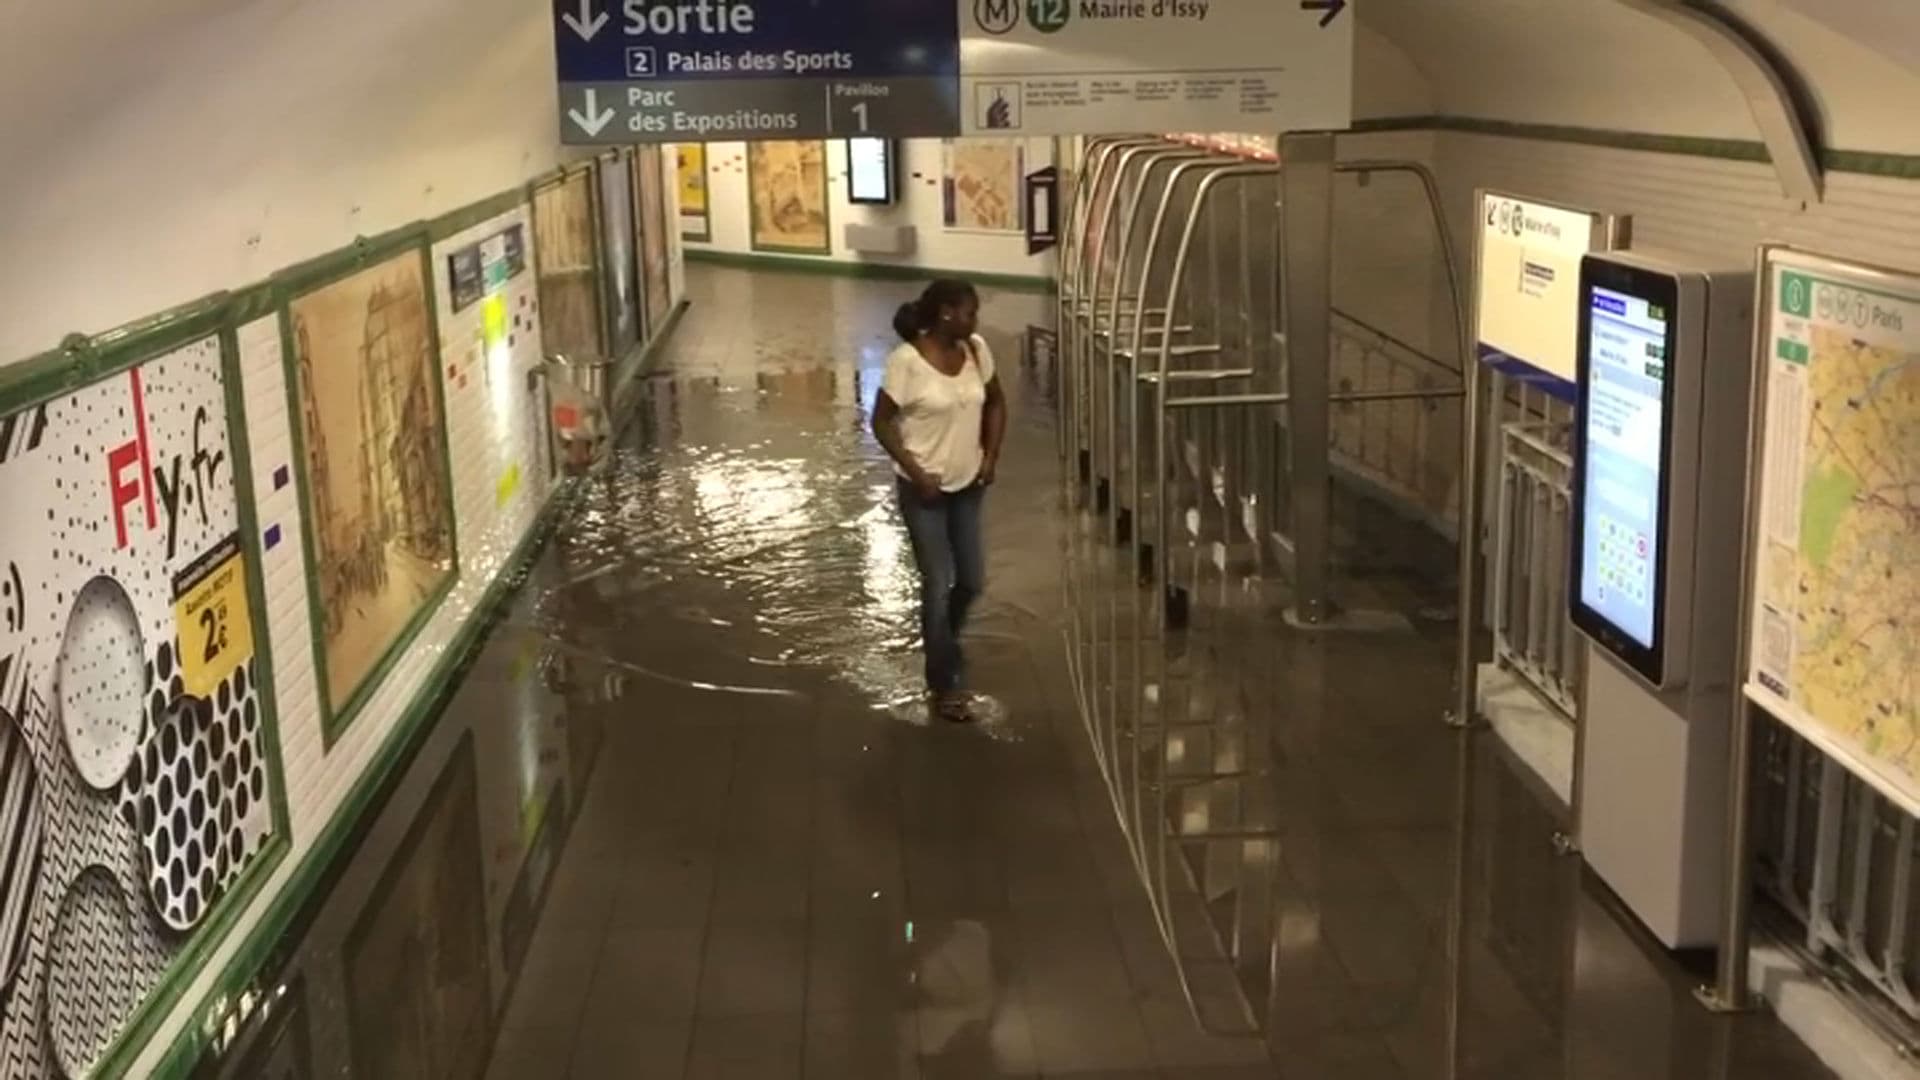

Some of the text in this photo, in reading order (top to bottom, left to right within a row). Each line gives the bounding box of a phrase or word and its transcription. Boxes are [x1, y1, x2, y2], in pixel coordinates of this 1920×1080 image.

[623, 0, 755, 35] Sortie
[1033, 0, 1065, 24] 12
[1079, 0, 1145, 19] Mairie
[1151, 0, 1209, 21] d'Issy
[633, 49, 853, 73] 2 Palais des Sports
[628, 83, 889, 107] Parc Pavillon
[628, 103, 869, 134] des Expositions 1
